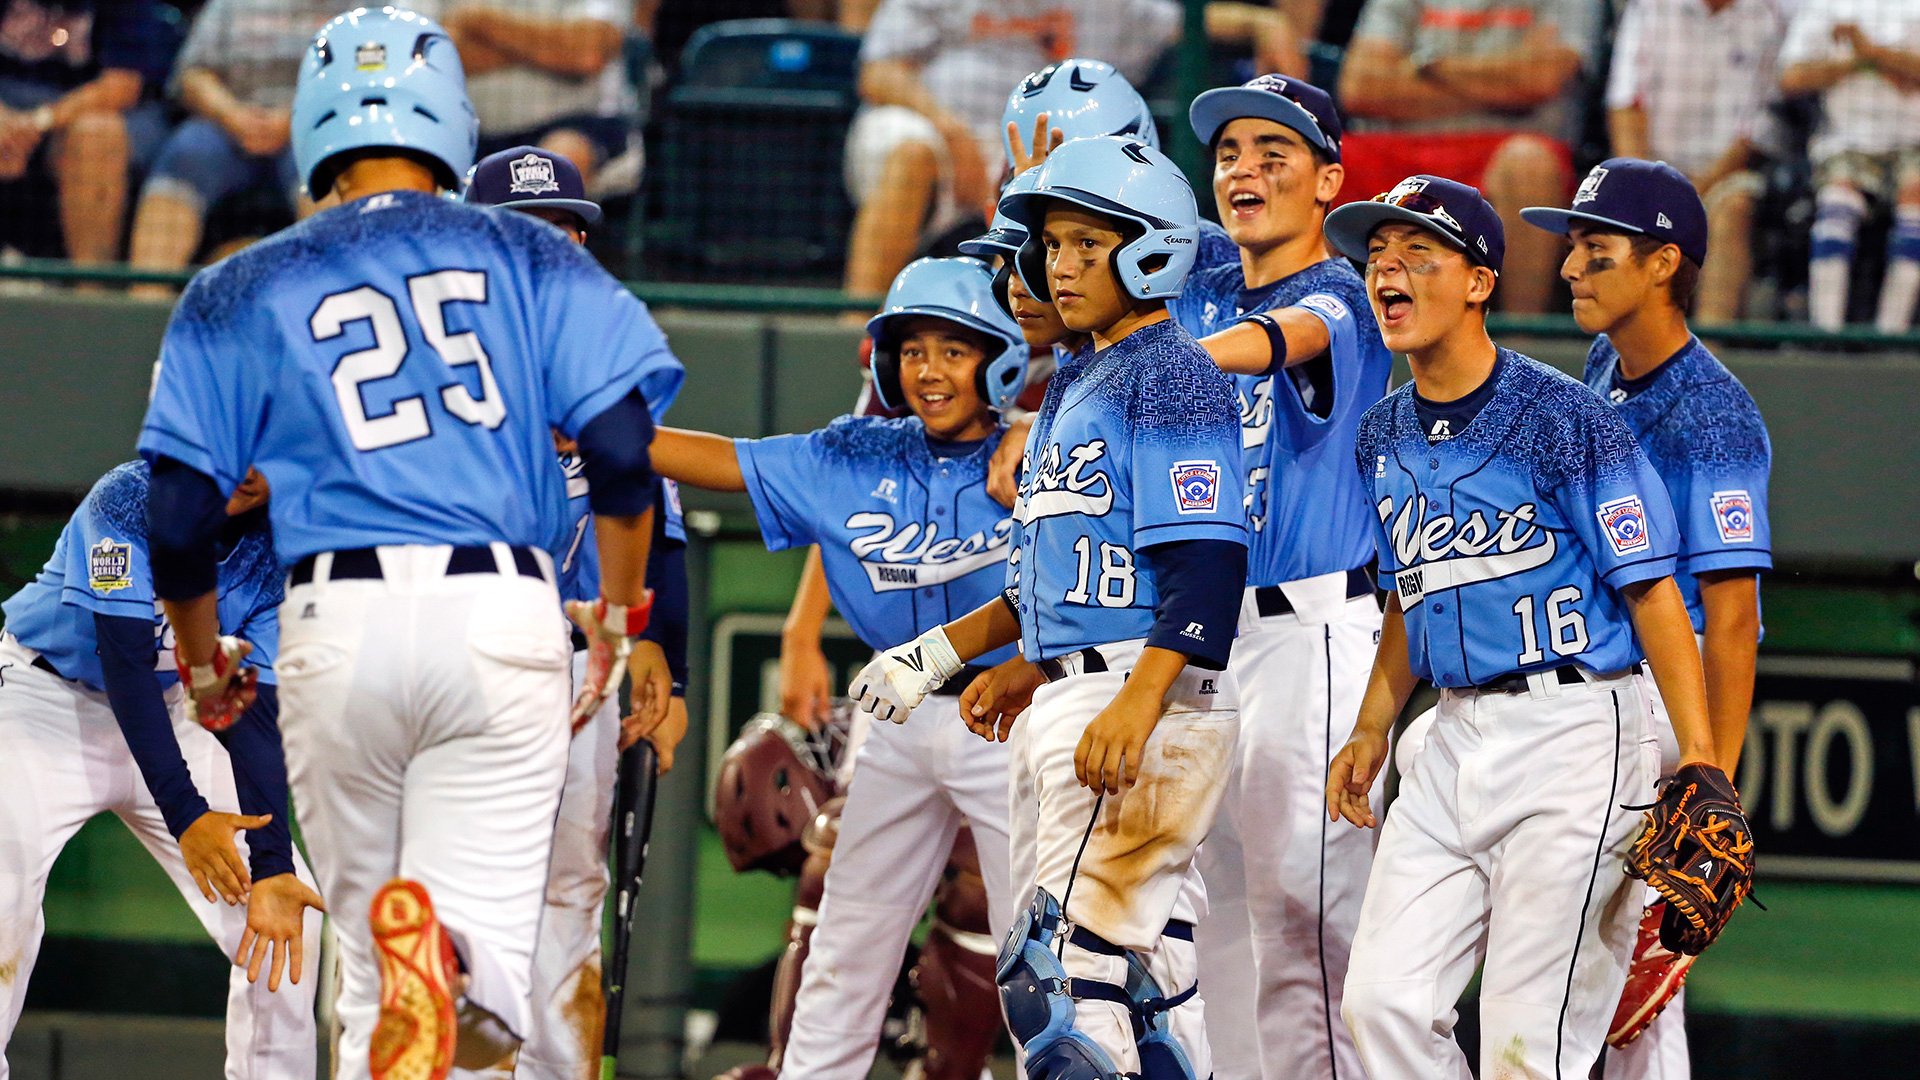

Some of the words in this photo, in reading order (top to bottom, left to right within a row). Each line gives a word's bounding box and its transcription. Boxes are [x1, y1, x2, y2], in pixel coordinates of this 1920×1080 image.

[310, 268, 507, 452] 25
[1377, 492, 1538, 567] West
[92, 556, 126, 567] WORLD
[93, 566, 123, 577] SERIES
[877, 566, 918, 584] REGION
[1064, 535, 1136, 608] 18
[1512, 584, 1590, 667] 16
[1179, 630, 1206, 642] RUSSELL
[1201, 679, 1214, 691] R
